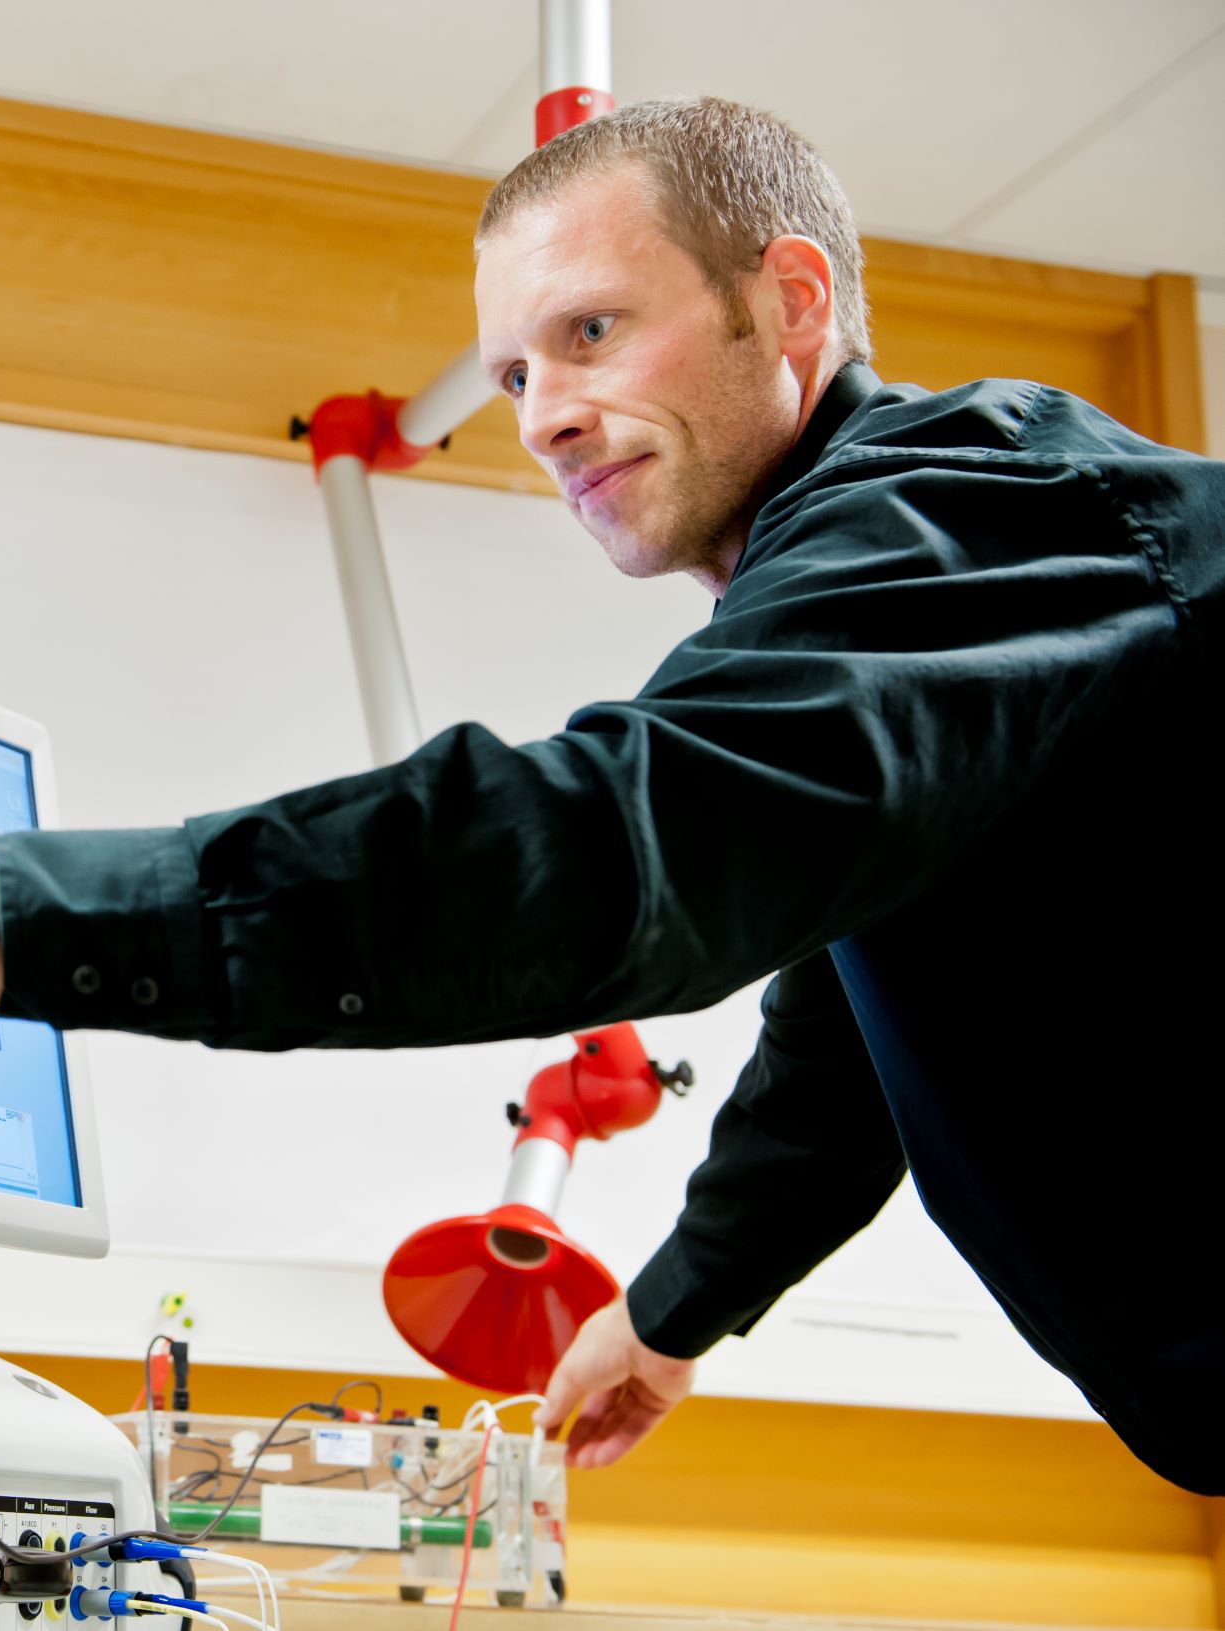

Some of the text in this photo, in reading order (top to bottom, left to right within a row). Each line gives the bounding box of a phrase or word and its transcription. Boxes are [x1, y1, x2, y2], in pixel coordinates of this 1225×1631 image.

[24, 1501, 35, 1511] Aux
[44, 1503, 66, 1513] Pressure
[85, 1505, 98, 1514] Flow
